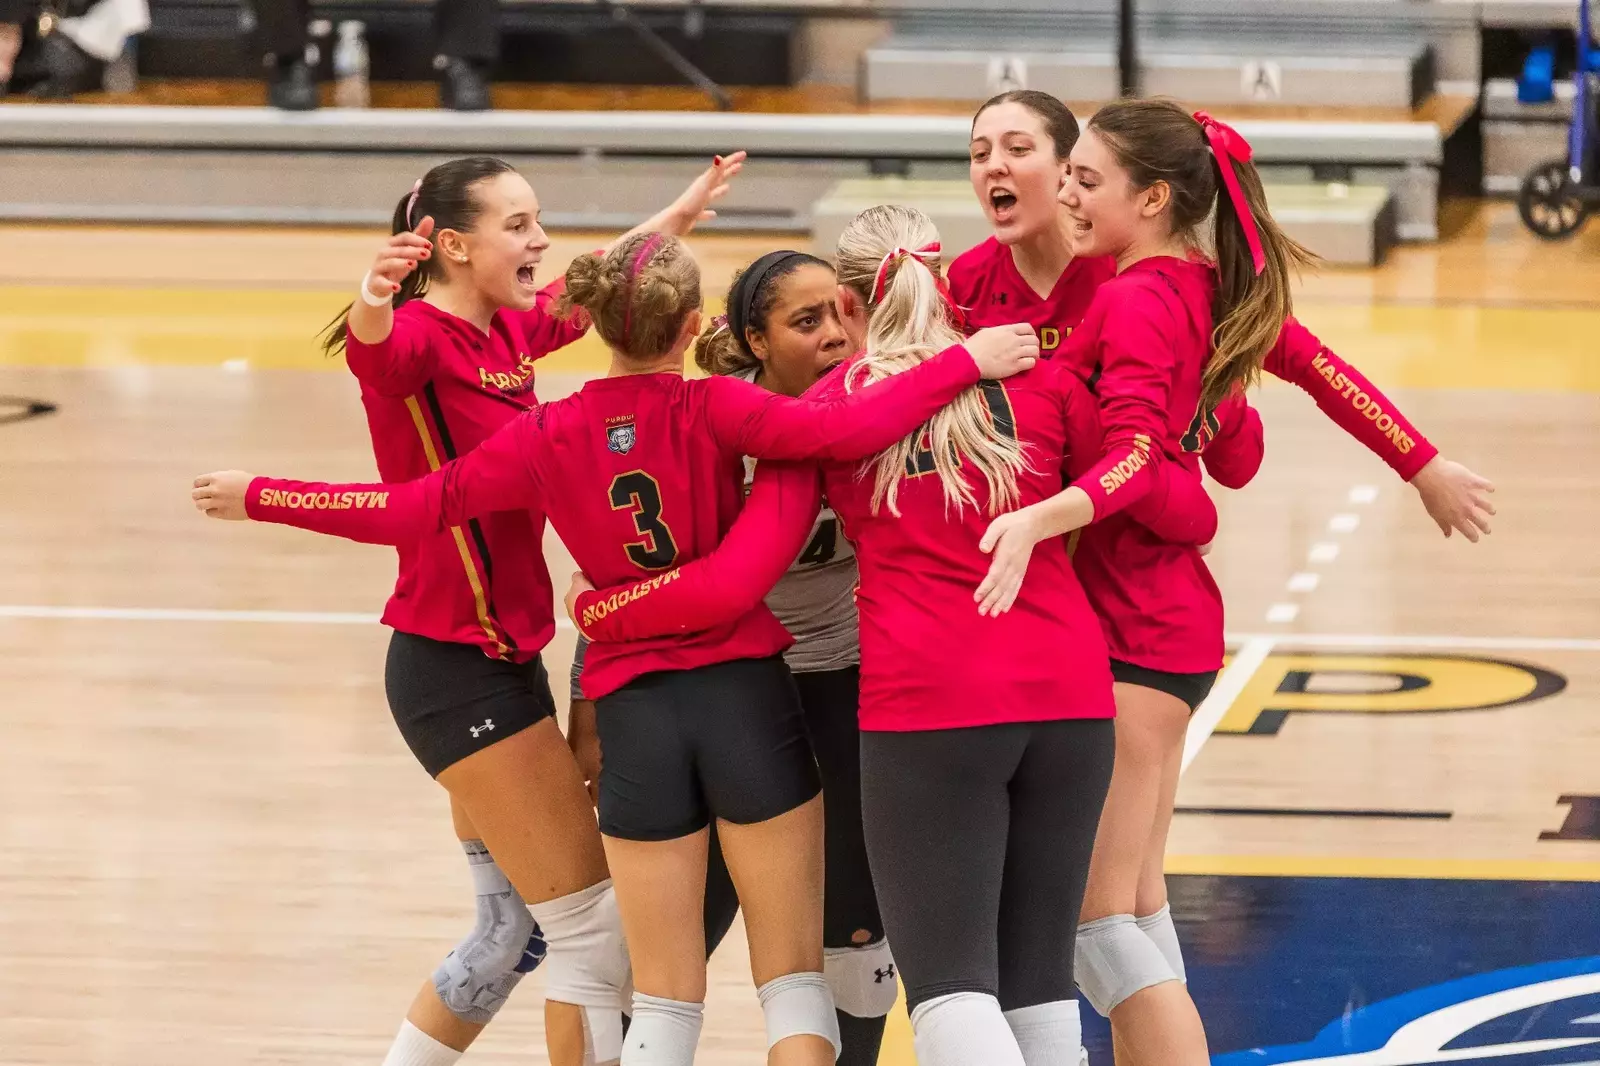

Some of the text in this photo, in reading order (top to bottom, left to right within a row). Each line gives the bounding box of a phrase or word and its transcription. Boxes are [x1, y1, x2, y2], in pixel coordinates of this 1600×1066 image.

[1311, 351, 1416, 454] MASTODONS
[259, 487, 390, 510] MASTODONS
[607, 468, 680, 571] 3
[582, 566, 681, 627] MASTODON
